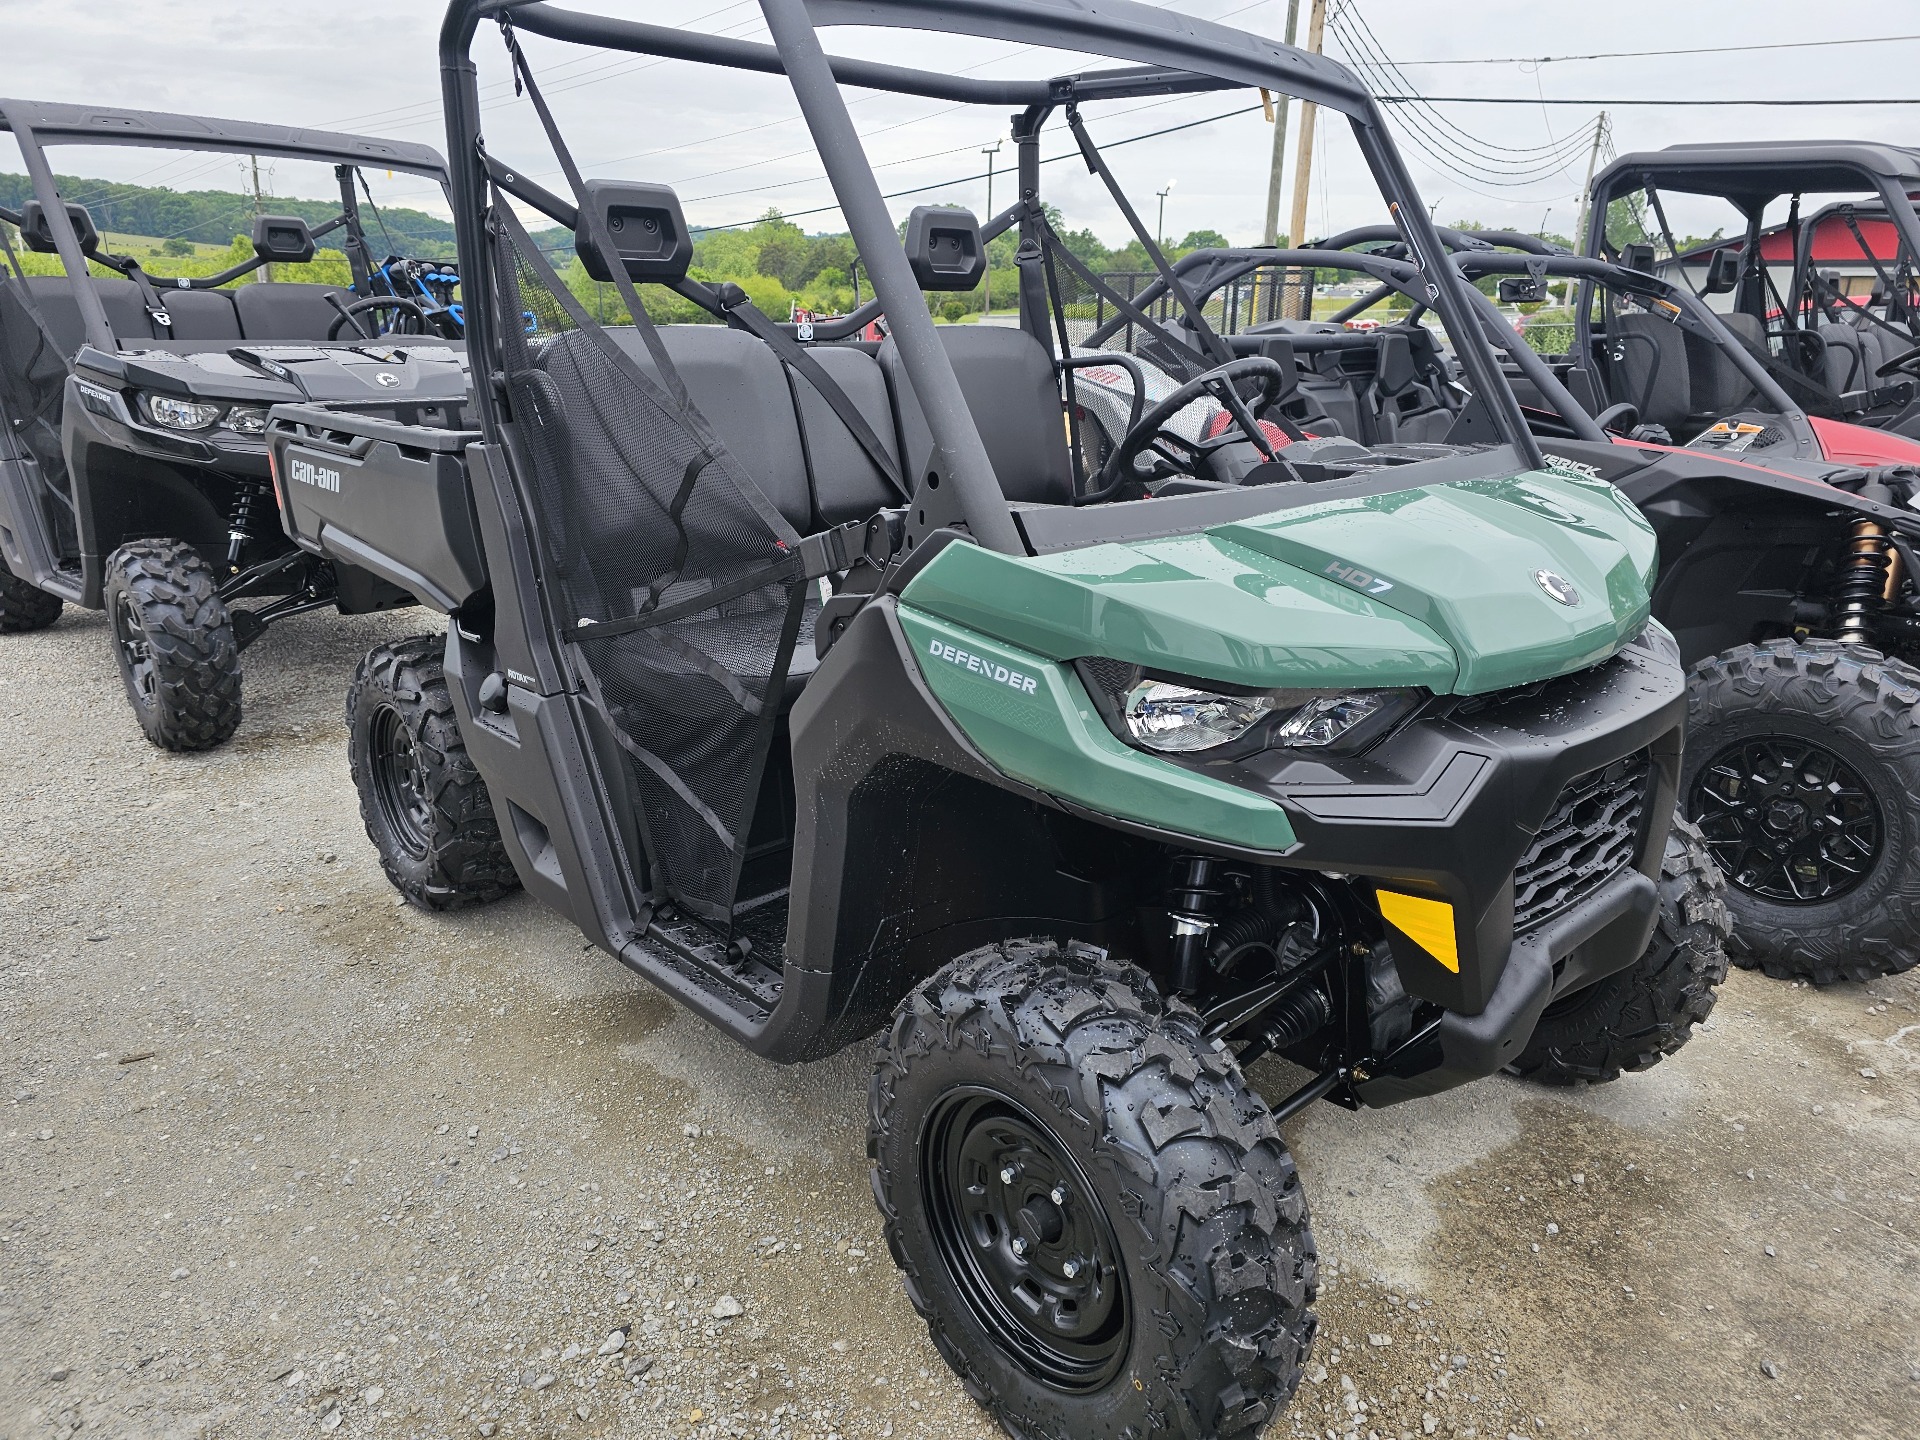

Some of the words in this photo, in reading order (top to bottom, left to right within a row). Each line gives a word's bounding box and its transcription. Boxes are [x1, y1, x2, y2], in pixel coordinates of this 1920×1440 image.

[80, 385, 111, 402] DEFENDER
[291, 459, 340, 493] can-am
[1324, 561, 1394, 594] HD7
[929, 639, 1038, 695] DEFENDER
